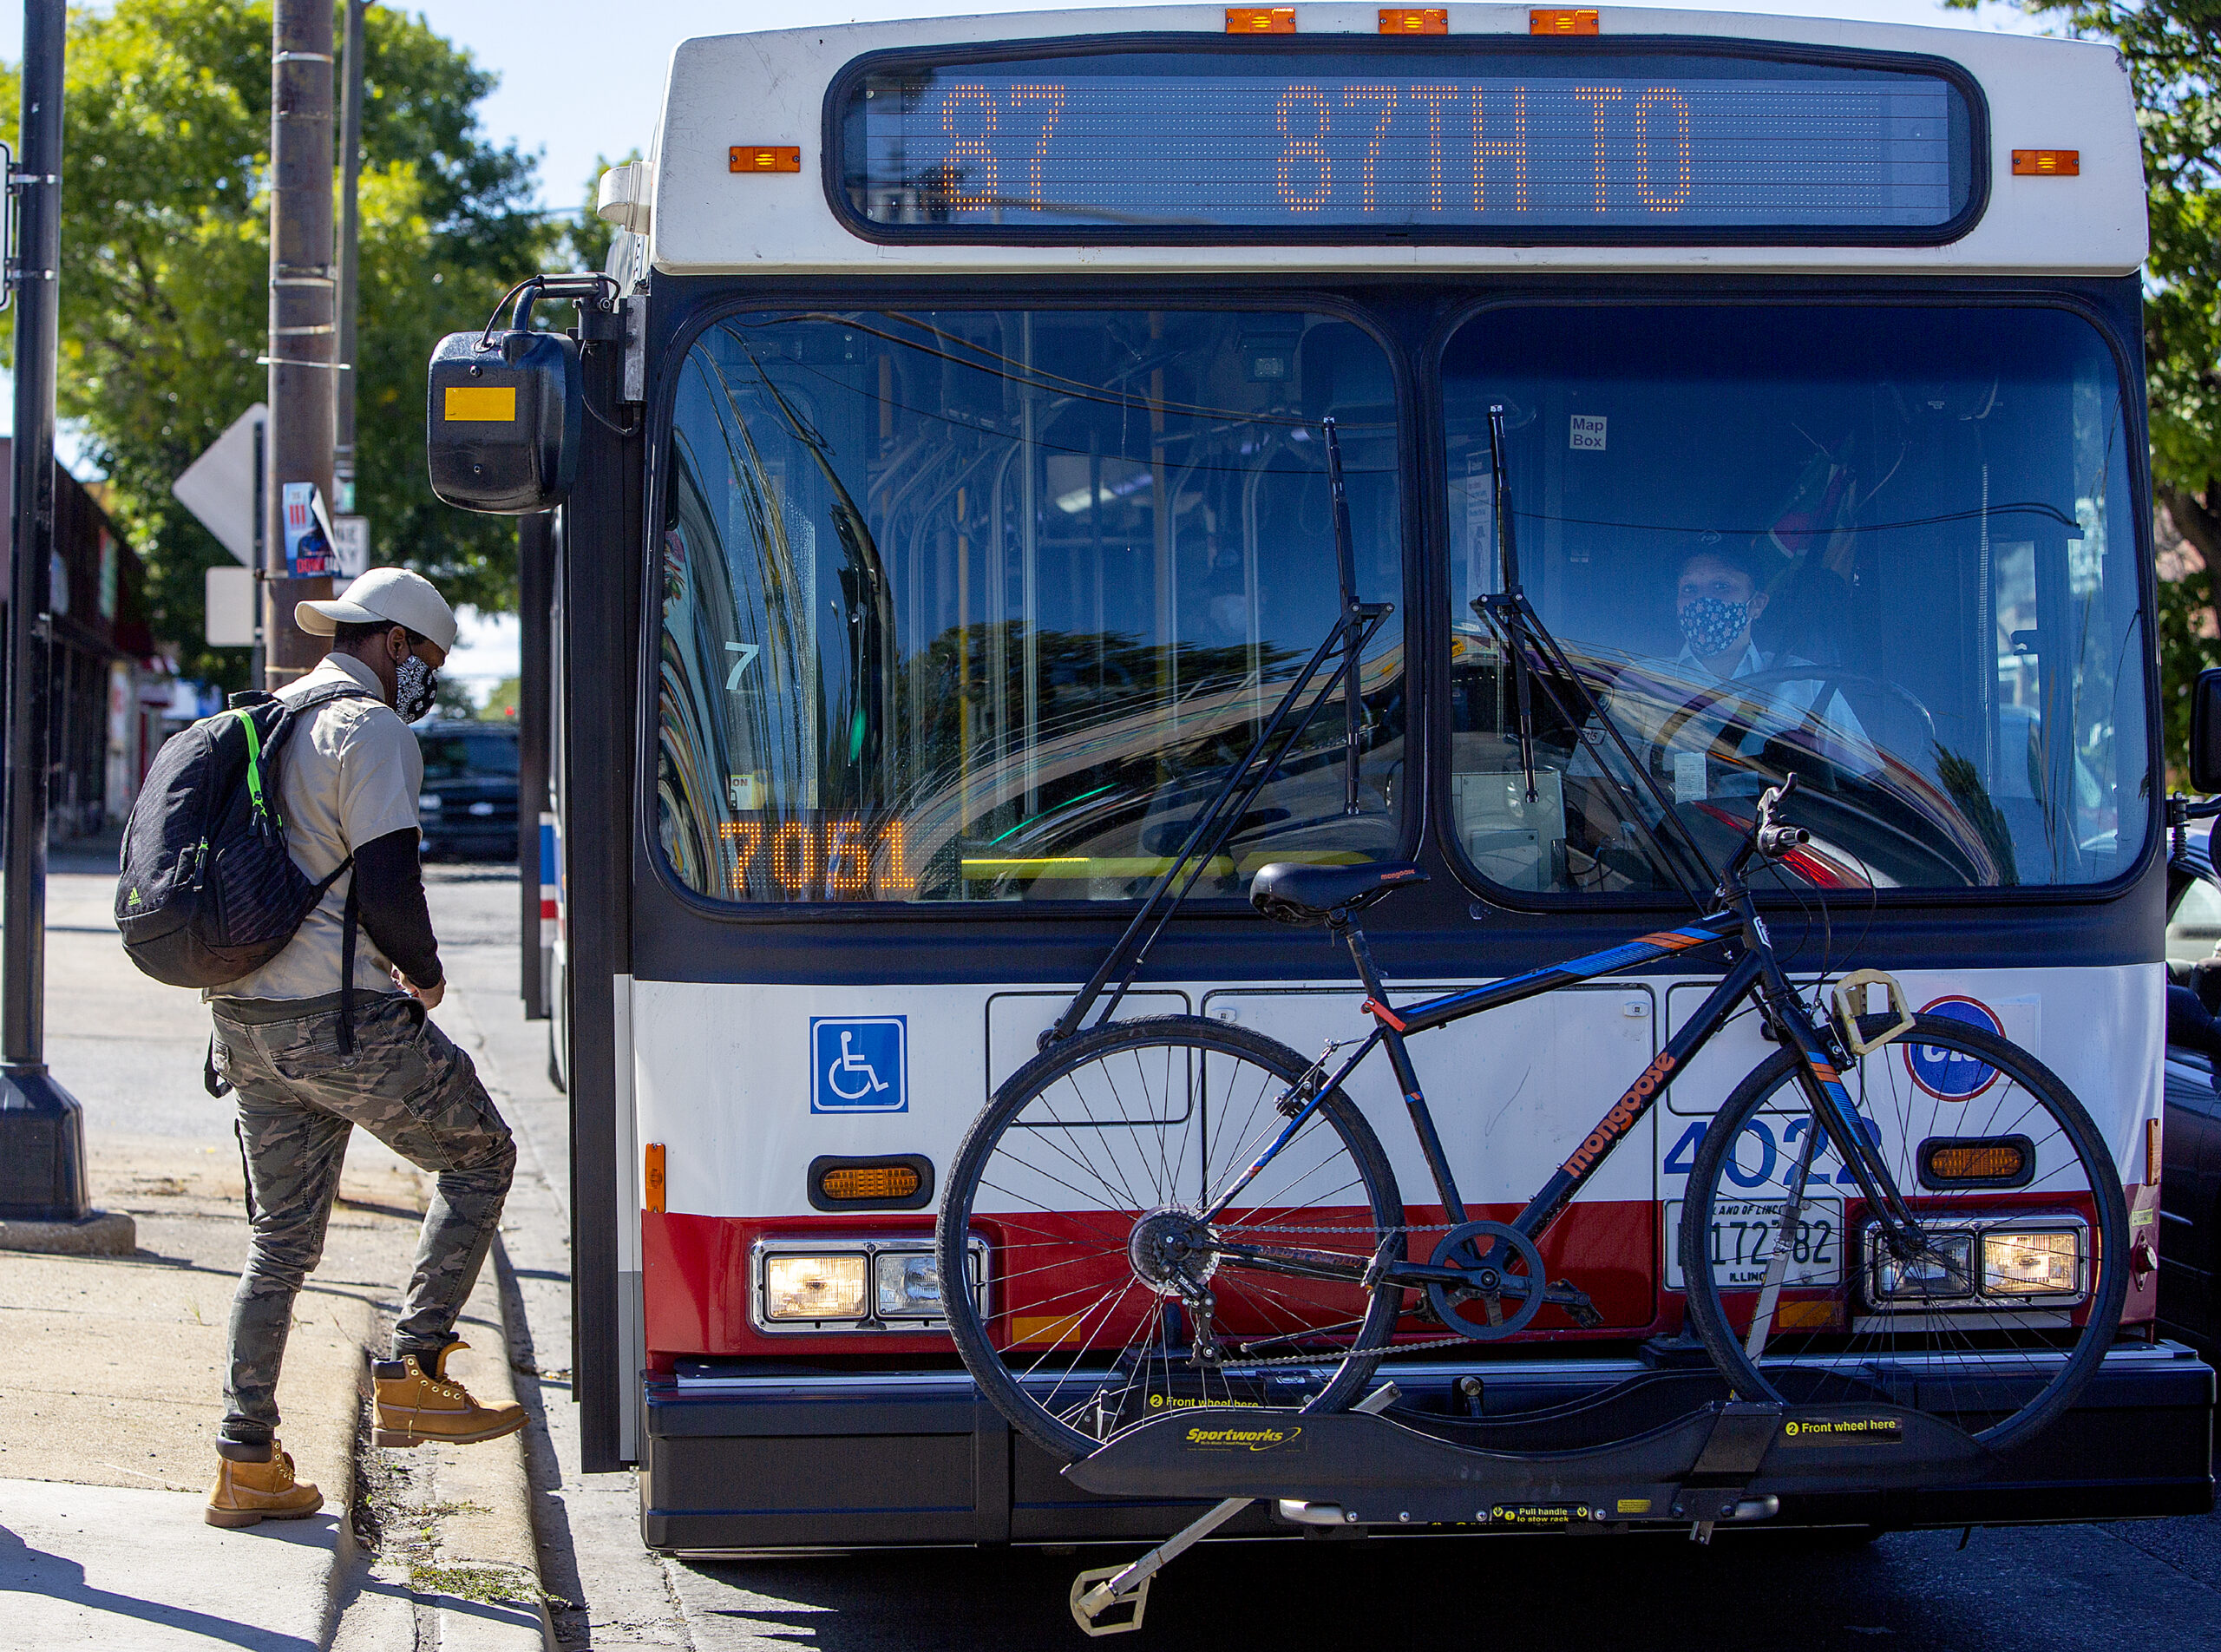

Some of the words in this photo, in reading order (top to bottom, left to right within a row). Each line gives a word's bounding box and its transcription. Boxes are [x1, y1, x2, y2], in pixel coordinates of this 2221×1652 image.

[942, 84, 1065, 211] 87
[1276, 84, 1526, 211] 87TH
[1575, 87, 1690, 212] TO
[1572, 417, 1604, 434] Map
[1573, 434, 1602, 447] Box
[724, 641, 760, 691] 7
[732, 778, 748, 787] ON
[720, 822, 914, 888] 7051
[1380, 869, 1415, 880] mongoose
[1563, 1051, 1677, 1178] mongoose
[1741, 1204, 1754, 1215] OF
[1711, 1220, 1832, 1265] 17282
[1166, 1397, 1196, 1406] Front
[1198, 1398, 1231, 1406] wheel
[1801, 1422, 1832, 1433] Front
[1833, 1420, 1868, 1432] wheel
[1870, 1419, 1897, 1430] here
[1185, 1428, 1284, 1443] Sportworks
[1519, 1507, 1536, 1516] Pull
[1537, 1507, 1568, 1516] handle
